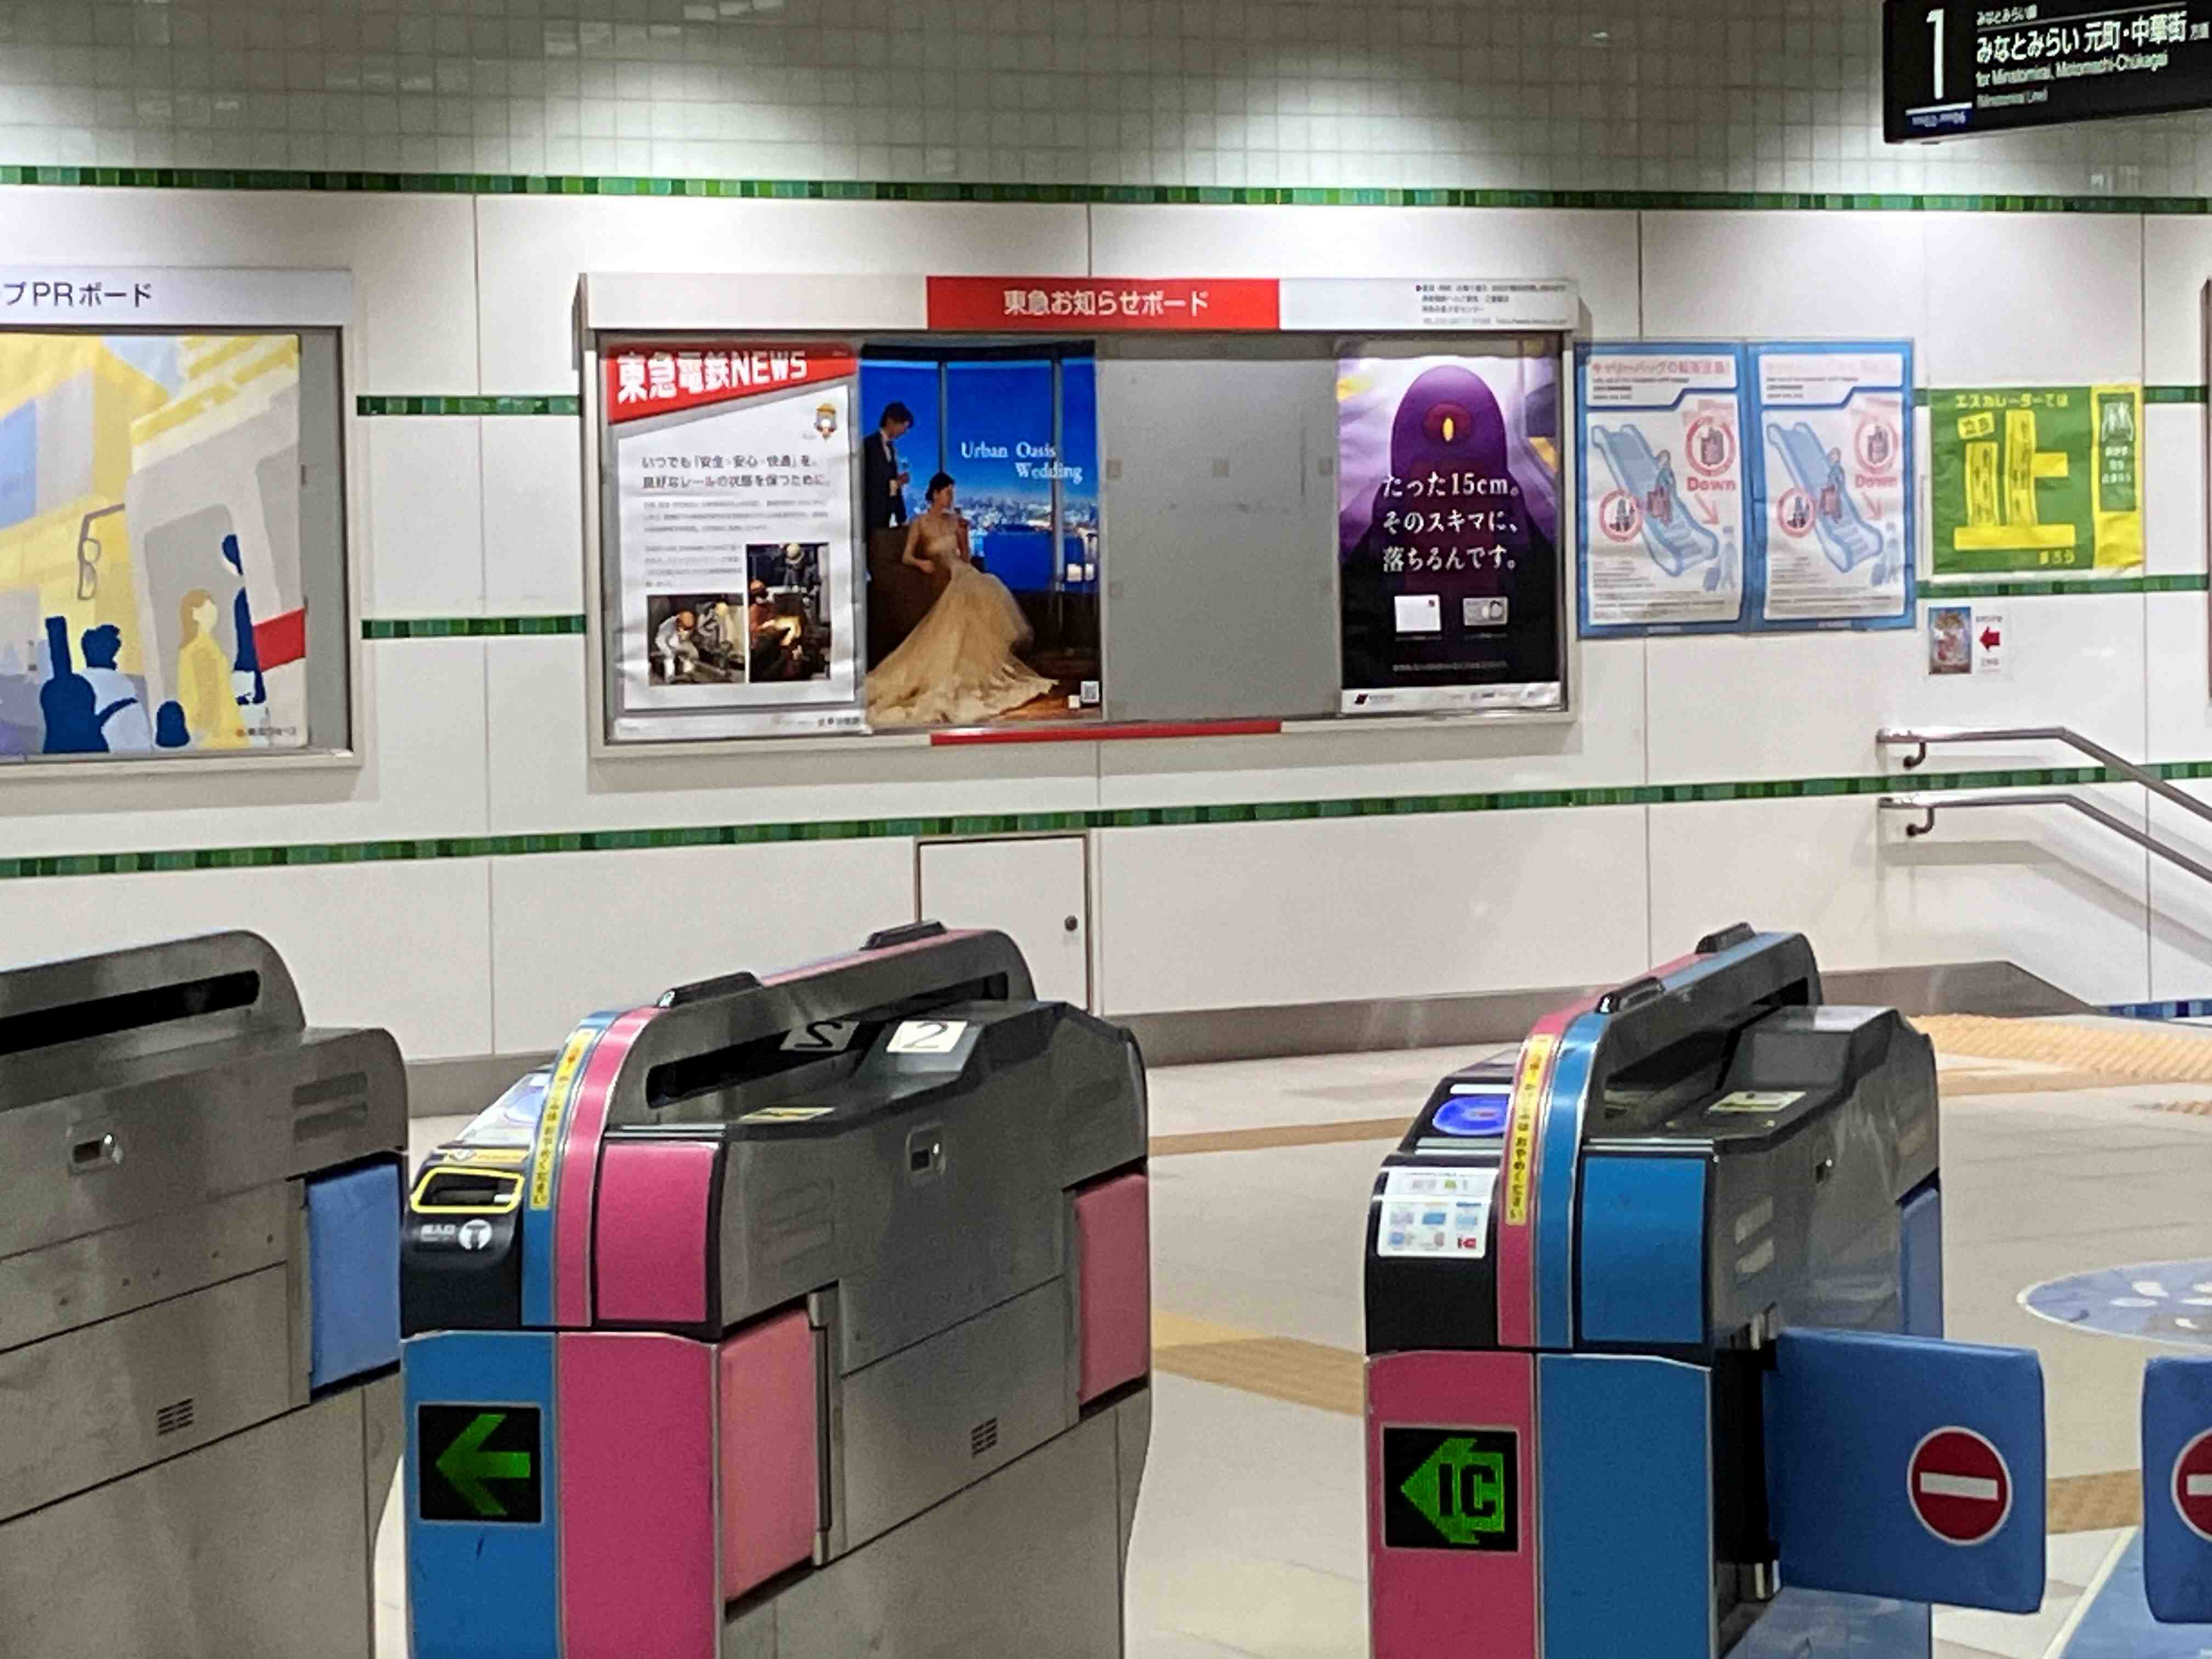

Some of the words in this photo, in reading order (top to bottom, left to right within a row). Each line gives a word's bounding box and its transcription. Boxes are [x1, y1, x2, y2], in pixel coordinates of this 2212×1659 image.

[1926, 8, 1945, 100] 1
[1977, 27, 2080, 64] みなとみらい
[3, 281, 153, 308] プPRボード
[1003, 290, 1209, 317] 東急お知らせボード
[617, 350, 808, 404] 東急電鉄NEWS
[961, 440, 1009, 459] Urban
[1016, 441, 1057, 458] Oasis
[1014, 461, 1084, 484] Wedding
[1383, 471, 1520, 498] たった15cm。
[1686, 476, 1736, 492] Down
[1854, 474, 1898, 488] Down
[1383, 510, 1519, 535] そのスキマに、
[1383, 544, 1517, 573] 落ちるんです。
[902, 1022, 949, 1048] 2
[1438, 1462, 1497, 1518] IC
